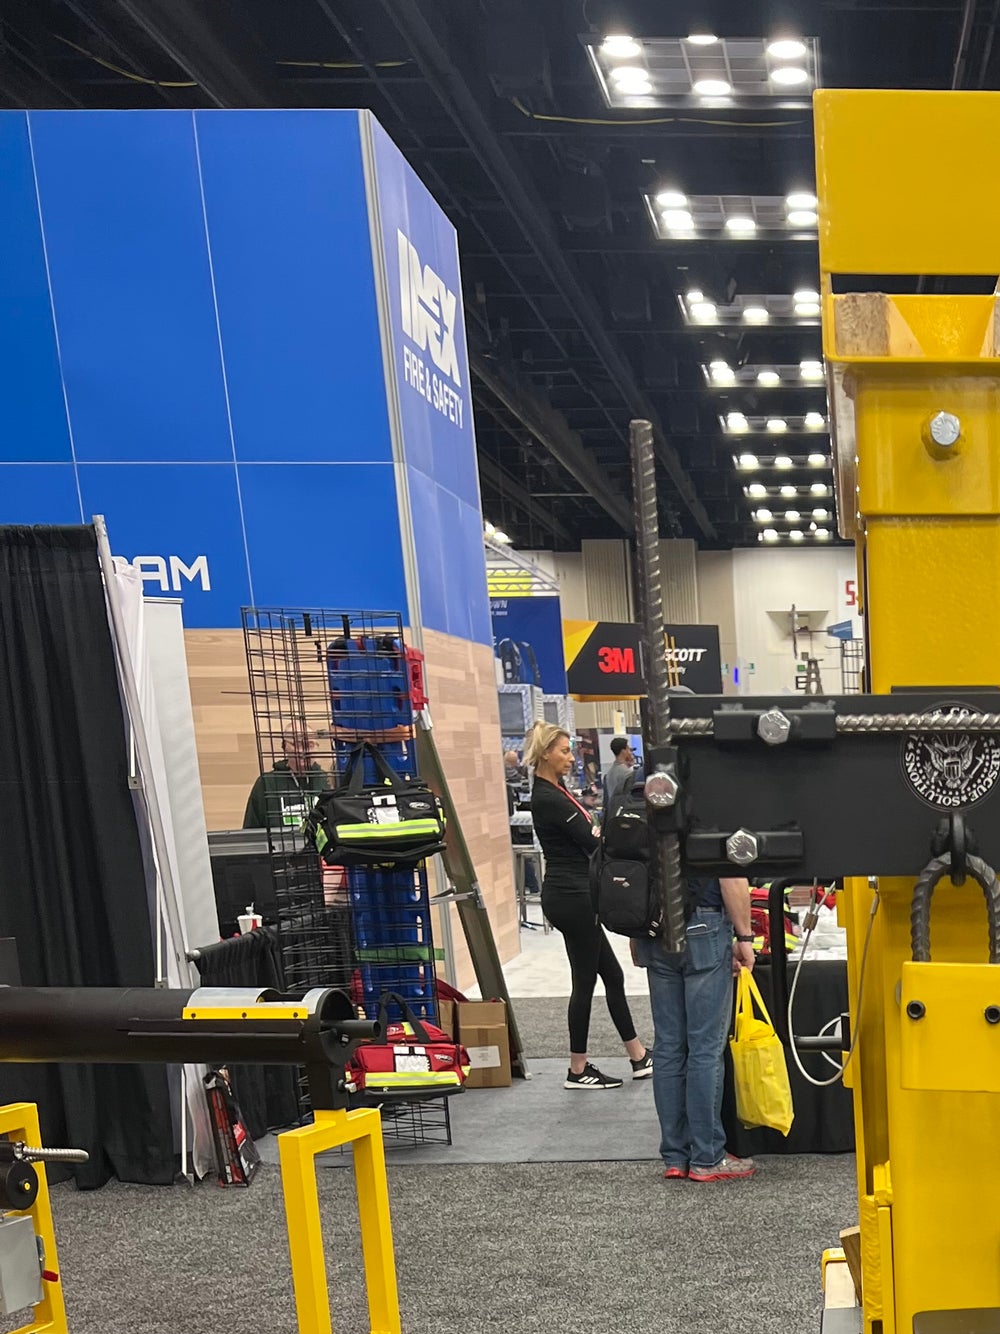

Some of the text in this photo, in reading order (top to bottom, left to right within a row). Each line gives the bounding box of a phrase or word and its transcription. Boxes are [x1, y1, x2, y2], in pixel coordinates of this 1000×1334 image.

[403, 345, 425, 397] FIRE
[432, 372, 464, 430] SAFETY
[598, 646, 708, 673] 3M SCOTT
[904, 747, 1000, 807] RESCUE SOLUTIONS
